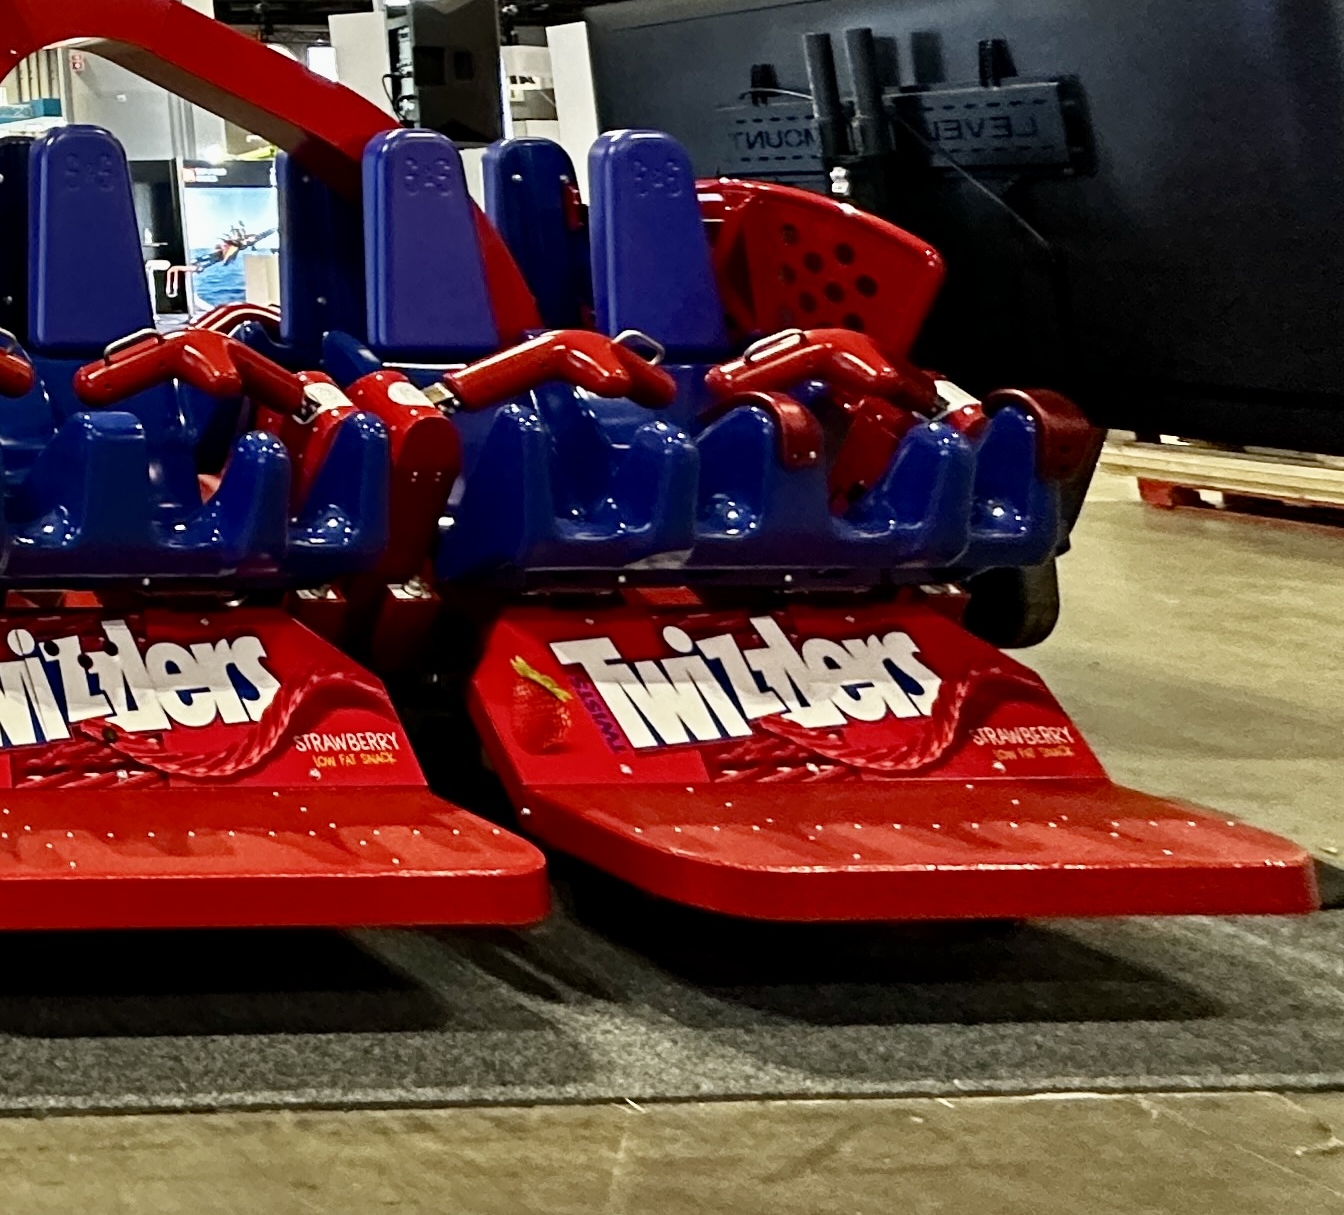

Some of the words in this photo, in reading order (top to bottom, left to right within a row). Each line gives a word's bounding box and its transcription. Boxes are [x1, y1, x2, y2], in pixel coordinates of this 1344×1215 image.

[293, 732, 400, 752] STRAWBERRY
[969, 726, 1075, 746] STRAWBERRY
[312, 755, 336, 768] LOW
[340, 754, 357, 766] FAT
[360, 752, 397, 765] SNACK
